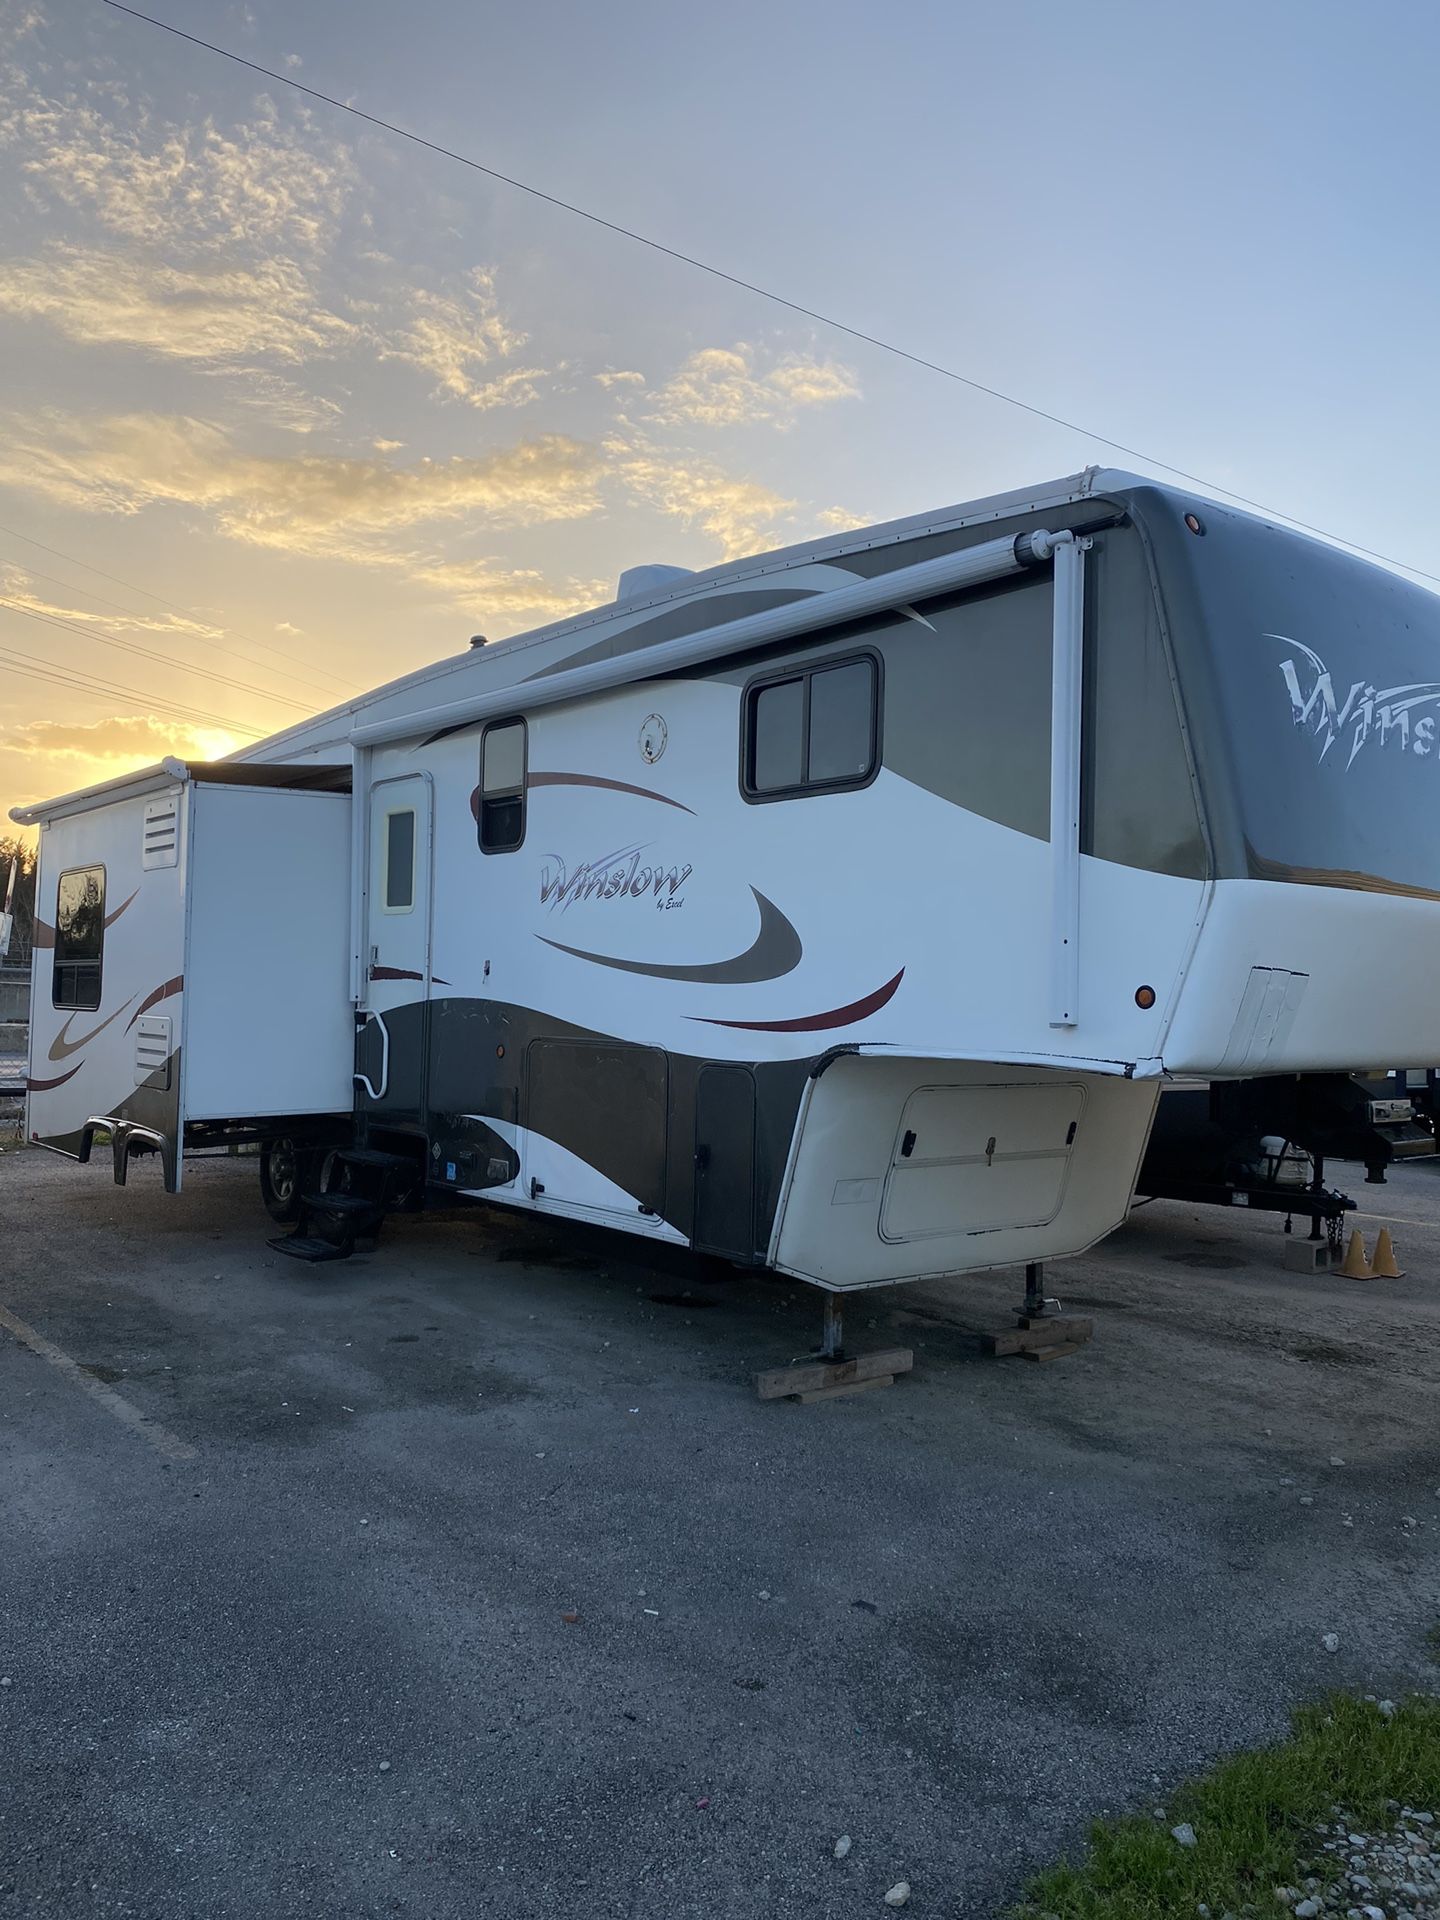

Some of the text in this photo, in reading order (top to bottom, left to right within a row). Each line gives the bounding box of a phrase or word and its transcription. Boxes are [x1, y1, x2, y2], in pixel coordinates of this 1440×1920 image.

[1270, 642, 1440, 766] Wins
[540, 847, 693, 905] Winslow
[656, 898, 664, 912] by
